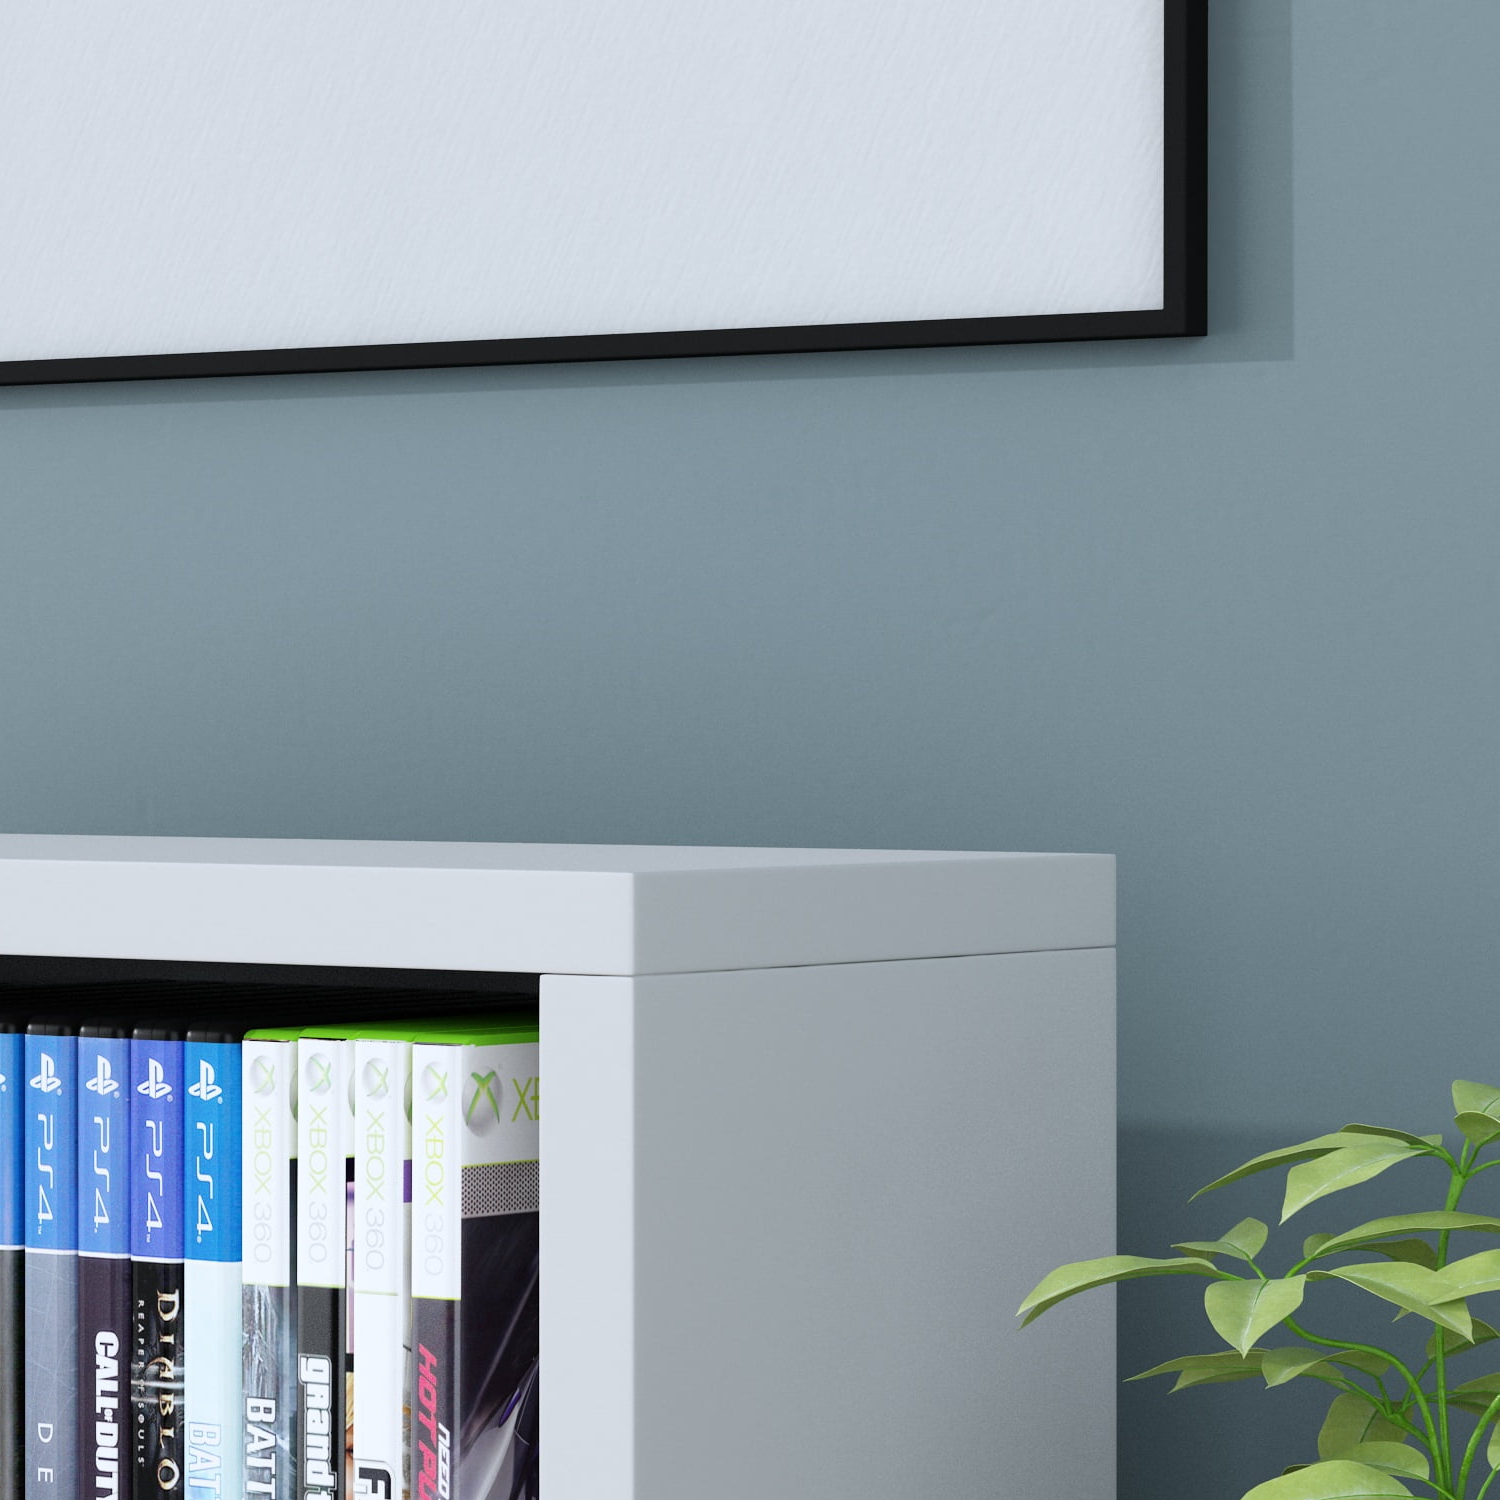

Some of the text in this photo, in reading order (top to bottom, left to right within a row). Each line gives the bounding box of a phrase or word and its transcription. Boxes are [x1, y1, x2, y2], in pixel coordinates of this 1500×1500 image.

[37, 1113, 54, 1224] PS4
[93, 1116, 110, 1228] PS4
[145, 1119, 163, 1232] PS4
[196, 1121, 214, 1235] PS4
[254, 1106, 272, 1263] XBOX 360
[309, 1104, 328, 1263] XBOX 360
[365, 1109, 385, 1271] XBOX 360
[424, 1114, 445, 1276] XBOX 360
[95, 1330, 119, 1414] CALL
[137, 1299, 145, 1376] REAPER
[150, 1288, 180, 1491] DIABLO
[137, 1402, 145, 1462] SOULS
[299, 1354, 336, 1488] grand
[418, 1343, 437, 1448] HOT
[437, 1422, 451, 1500] NEED
